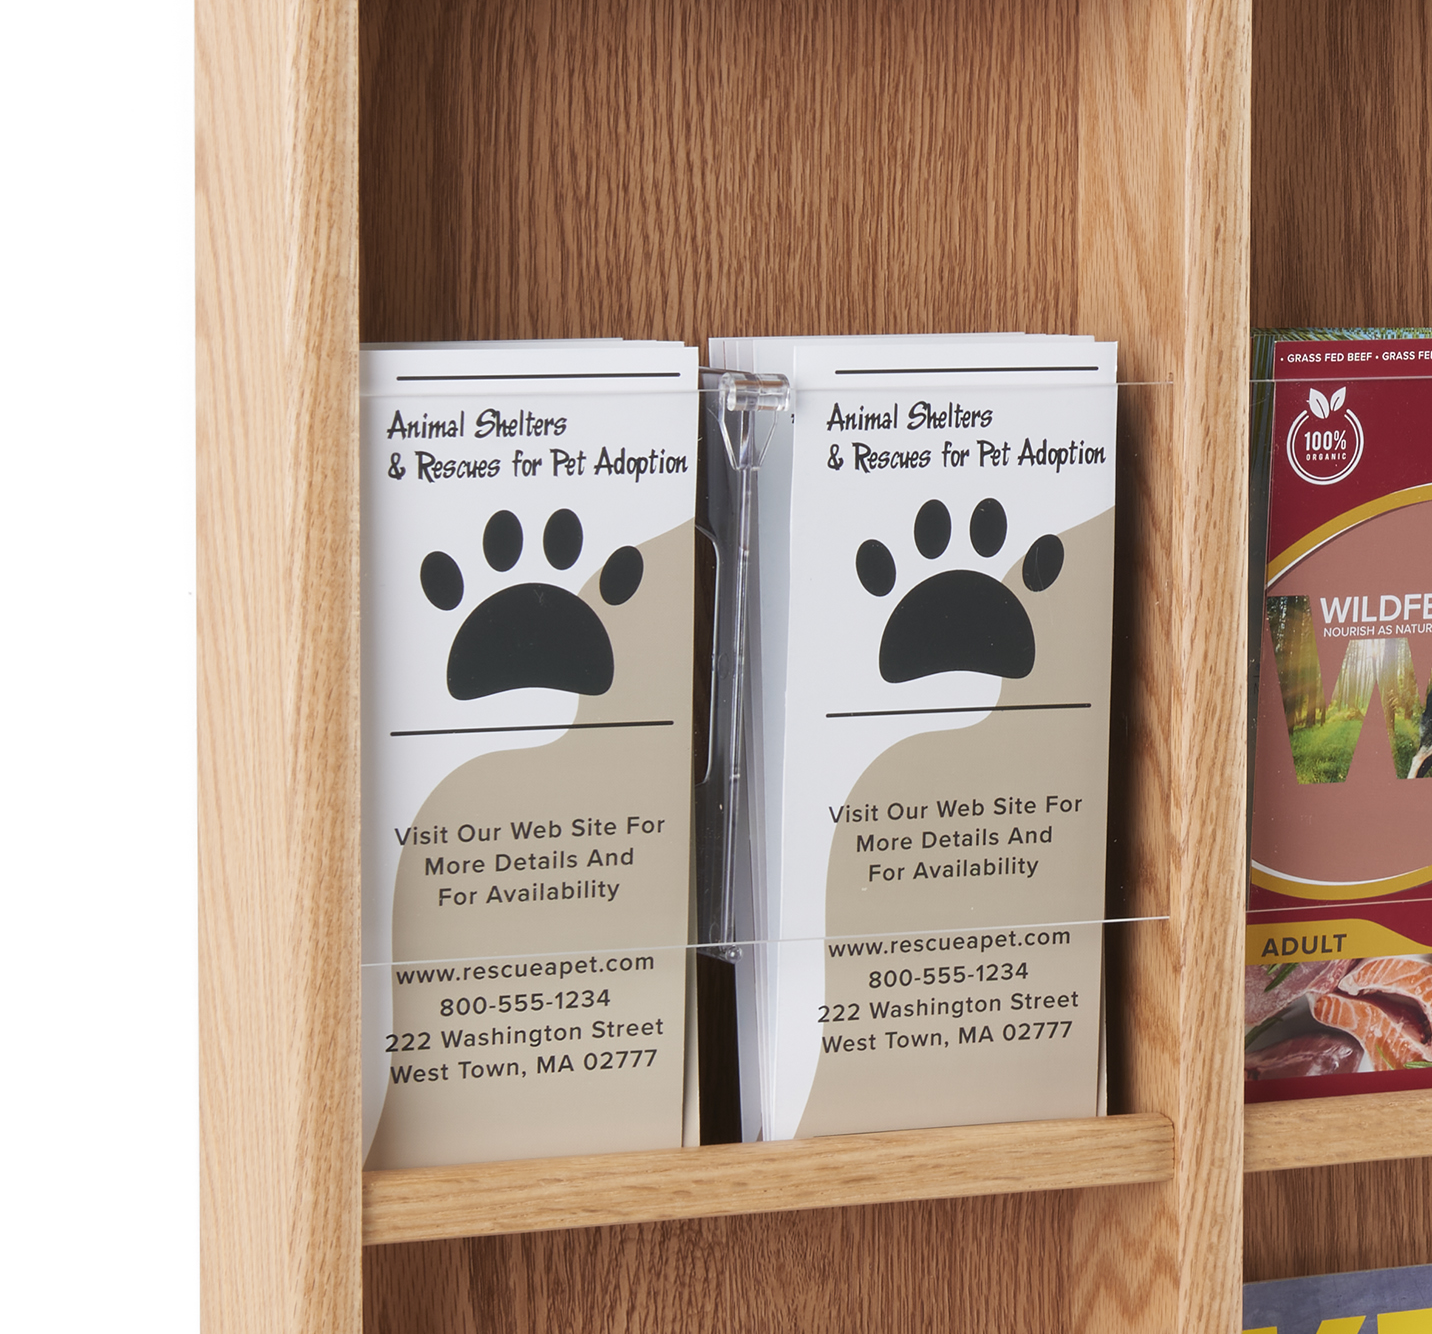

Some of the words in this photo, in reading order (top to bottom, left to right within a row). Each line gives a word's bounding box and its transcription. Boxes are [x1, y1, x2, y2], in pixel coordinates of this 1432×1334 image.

[1287, 353, 1322, 362] GRASS
[1324, 353, 1344, 361] FED
[1348, 352, 1372, 361] BEEF
[387, 410, 465, 441] Animal
[475, 408, 567, 438] Shelters
[1304, 430, 1347, 451] 100%
[387, 454, 405, 479] &
[418, 451, 500, 483] Rescues
[512, 450, 543, 475] for
[552, 449, 586, 477] Pet
[594, 447, 688, 481] Adoption
[1306, 453, 1347, 461] ORGANIC
[1323, 625, 1375, 637] NOURISH
[1378, 625, 1392, 634] AS
[829, 804, 878, 823] Visit
[887, 802, 928, 821] Our
[937, 799, 984, 818] Web
[993, 797, 1036, 815] Site
[1046, 796, 1083, 813] For
[869, 864, 905, 882] For
[913, 857, 1038, 879] Availability
[1261, 934, 1347, 958] ADULT
[396, 956, 655, 985] www.rescueapet.com
[440, 989, 610, 1017] 800-555-1234
